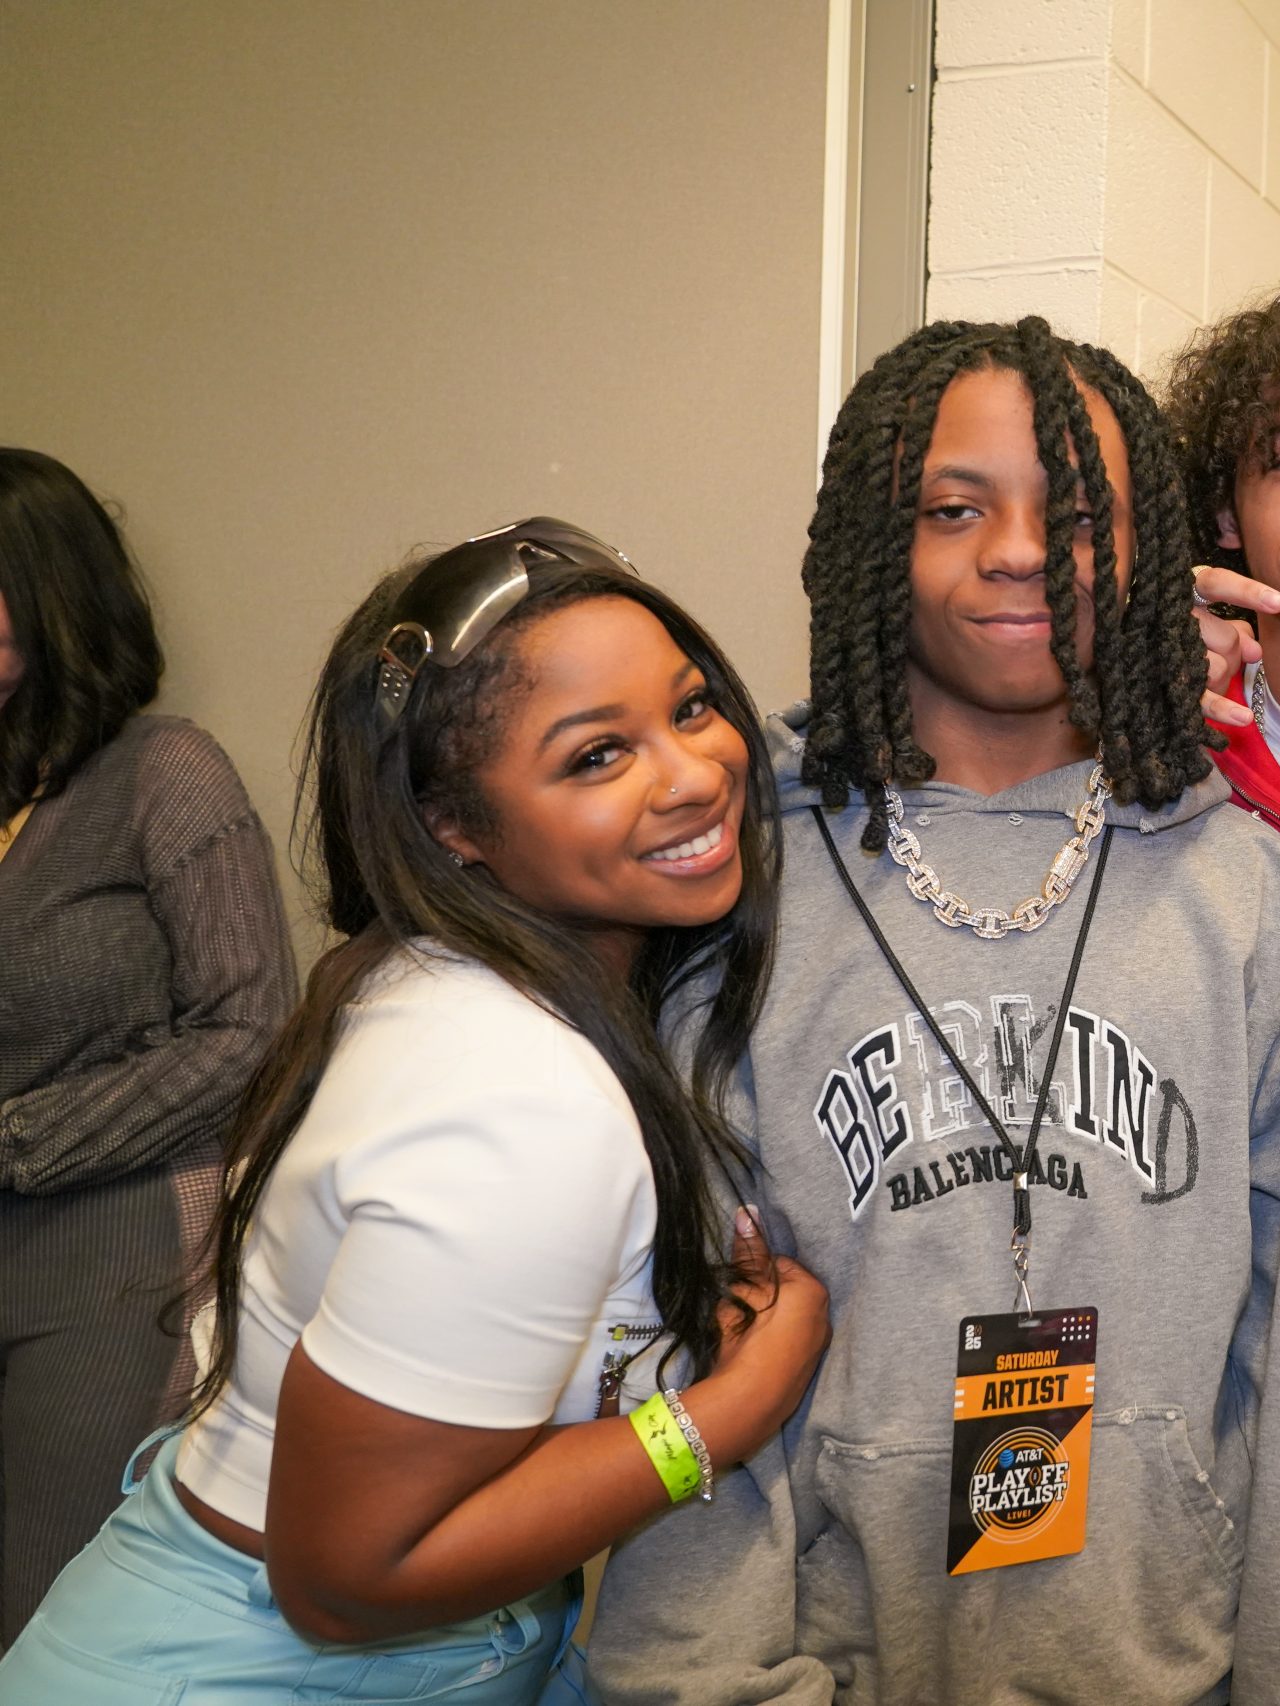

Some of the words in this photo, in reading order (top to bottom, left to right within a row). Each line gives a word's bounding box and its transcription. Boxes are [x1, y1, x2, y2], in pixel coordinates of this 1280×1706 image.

[996, 1350, 1059, 1371] SATURDAY
[982, 1374, 1069, 1411] ARTIST
[1015, 1448, 1044, 1463] AT&T
[971, 1483, 1067, 1514] PLAYLIST
[1007, 1510, 1031, 1521] LIVE!
